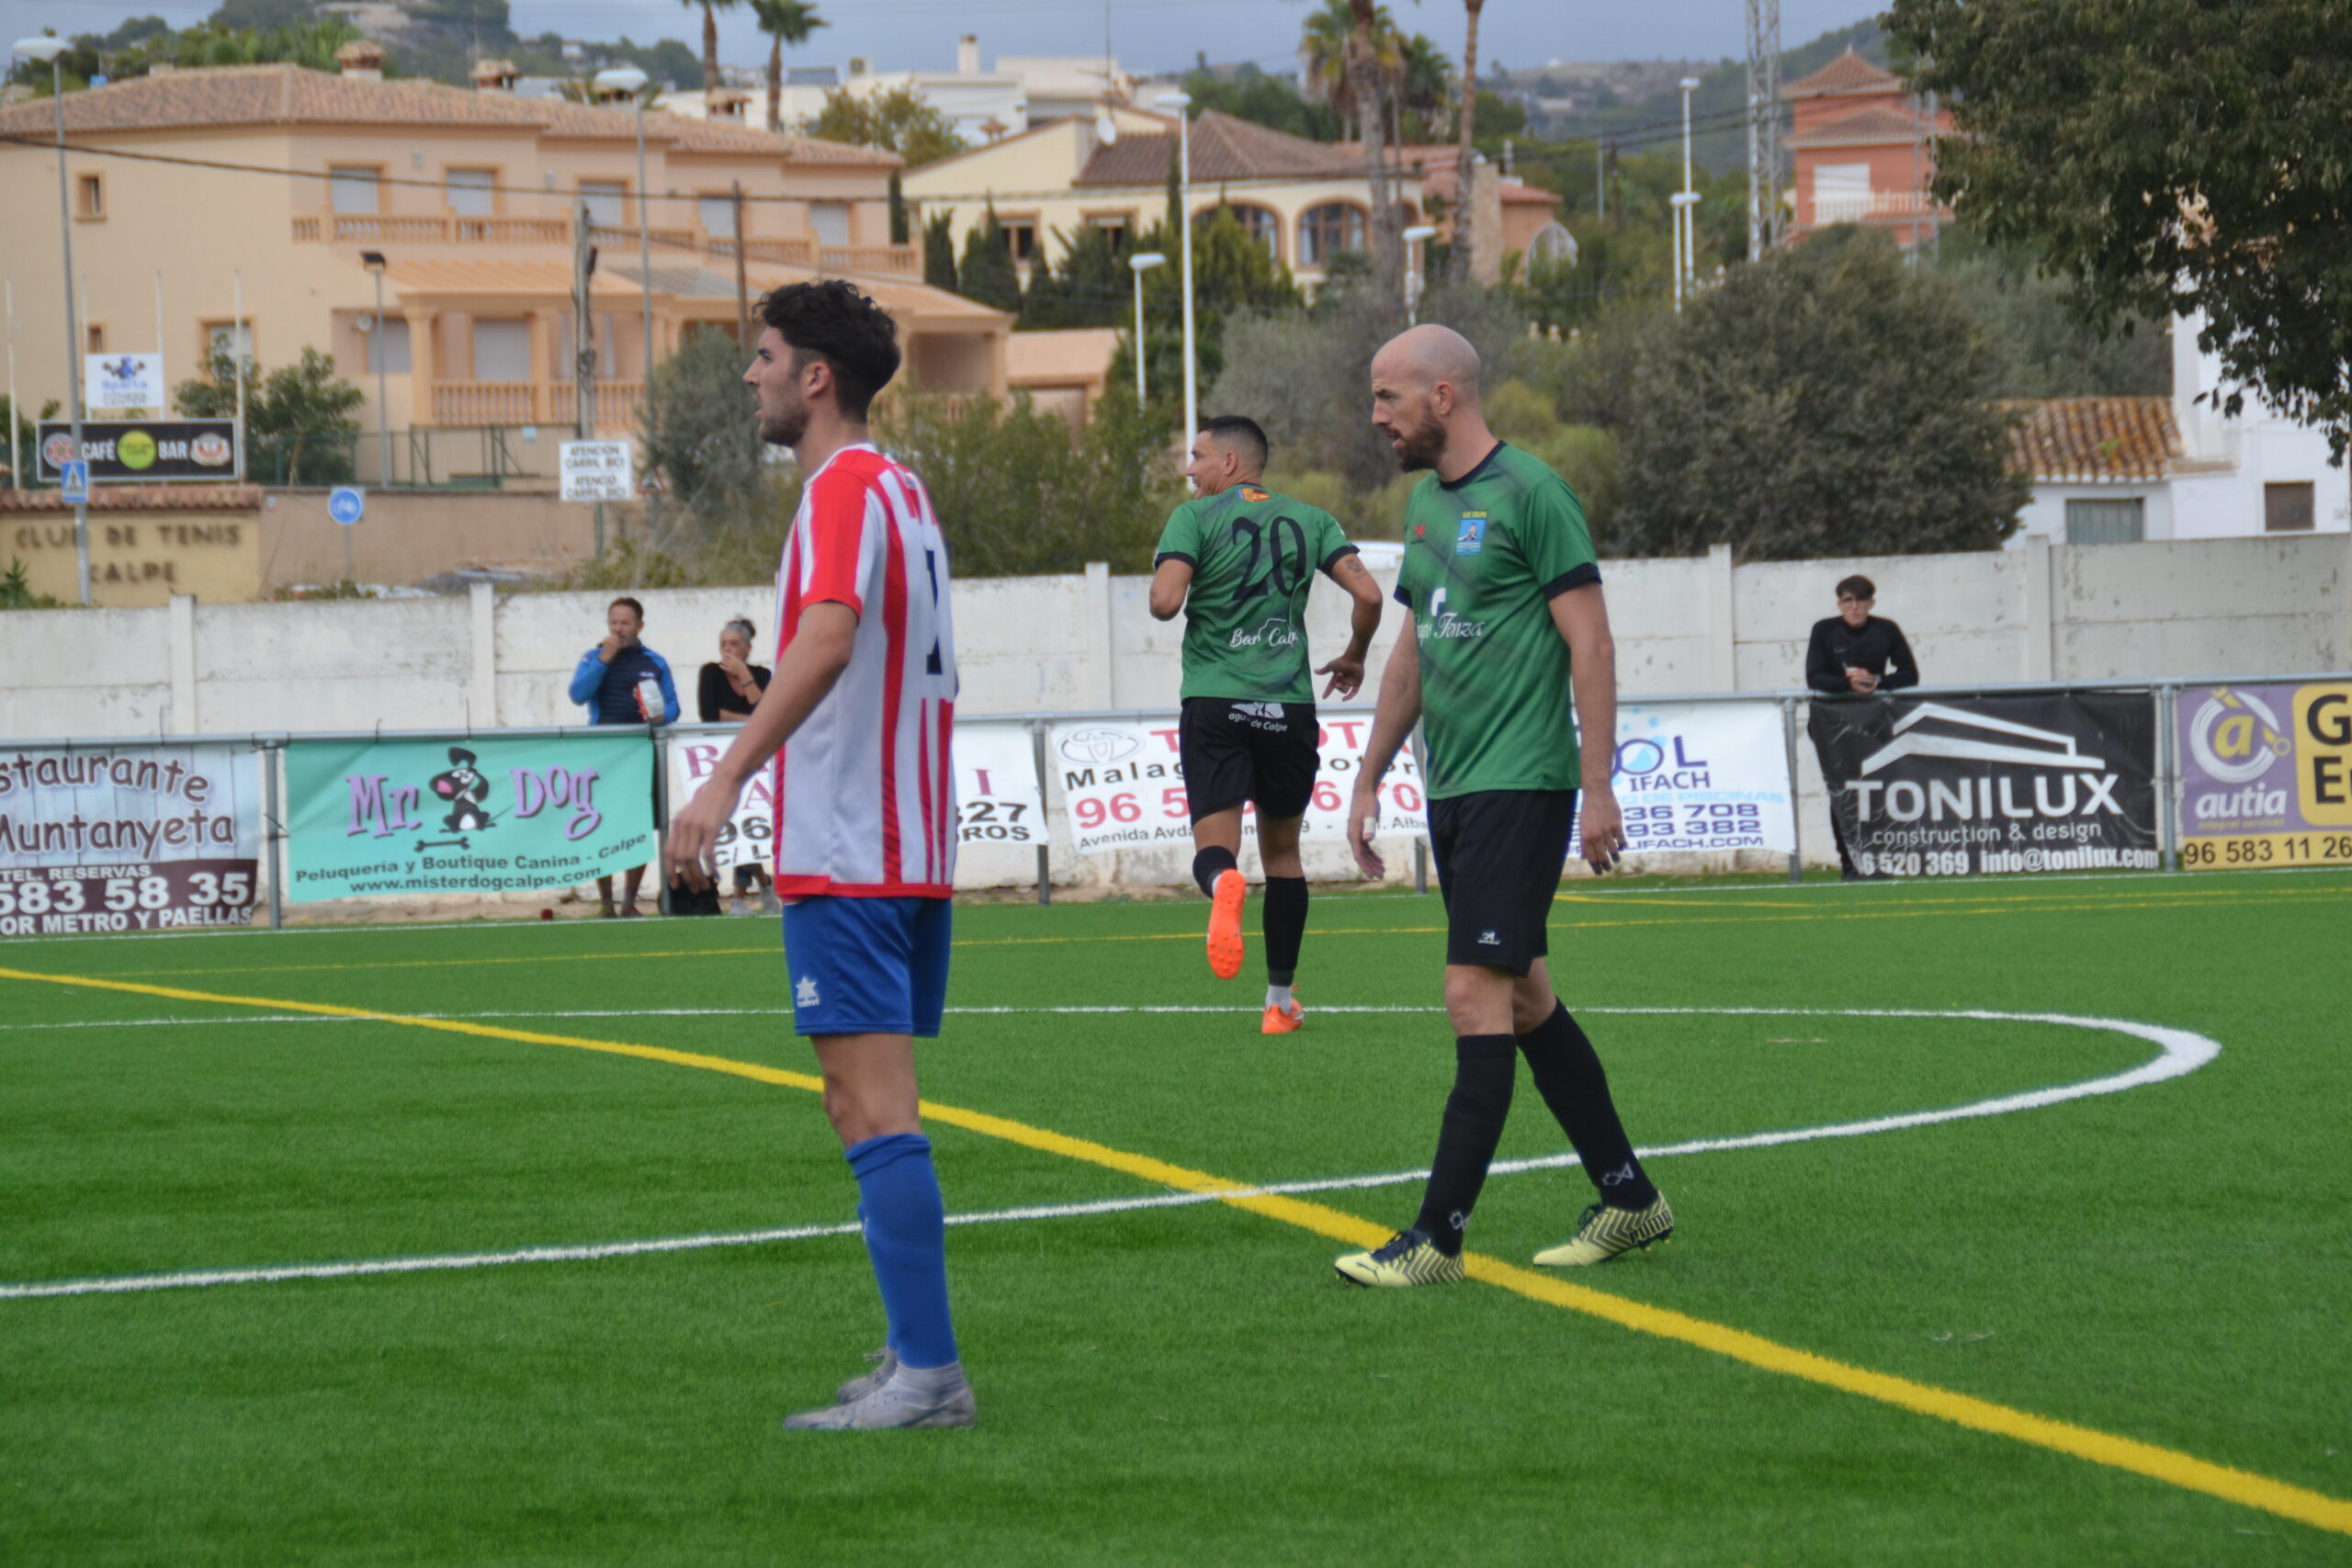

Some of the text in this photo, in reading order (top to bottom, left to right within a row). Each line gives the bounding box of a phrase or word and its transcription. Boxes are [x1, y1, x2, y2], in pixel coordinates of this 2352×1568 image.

[81, 438, 117, 460] CAFÉ
[158, 440, 187, 460] BAR
[106, 525, 137, 547] DE
[157, 523, 241, 547] TENIS
[1232, 514, 1307, 601] 20
[1230, 627, 1261, 648] Bar
[1250, 719, 1262, 728] de
[1263, 721, 1288, 733] Calpe
[1630, 772, 1711, 792] IFACH
[345, 774, 424, 839] Mr
[1679, 790, 1785, 805] PISCINAS
[1846, 773, 2123, 822] TONILUX
[2195, 782, 2288, 819] autia
[1075, 793, 1143, 829] 96
[1623, 803, 1760, 821] 36 708
[1080, 828, 1149, 849] Avenida
[1624, 819, 1762, 838] 93 382
[1871, 823, 2103, 846] construction & design
[405, 861, 416, 874] y
[423, 855, 509, 872] Boutique
[514, 854, 581, 870] Canina
[599, 832, 647, 859] Calpe
[1624, 836, 1764, 852] LIFACH.COM
[2184, 836, 2352, 865] 96 583 11 26
[49, 865, 152, 881] RESERVAS
[1879, 852, 1922, 876] 520
[1926, 851, 1971, 875] 369
[1980, 846, 2159, 874] info@tonilux.com
[350, 865, 602, 893] www.misterdogcalpe.com
[104, 875, 170, 911] 58
[187, 872, 249, 907] 35
[42, 912, 128, 934] METRO
[134, 910, 152, 931] Y
[159, 905, 252, 928] PAELLAS
